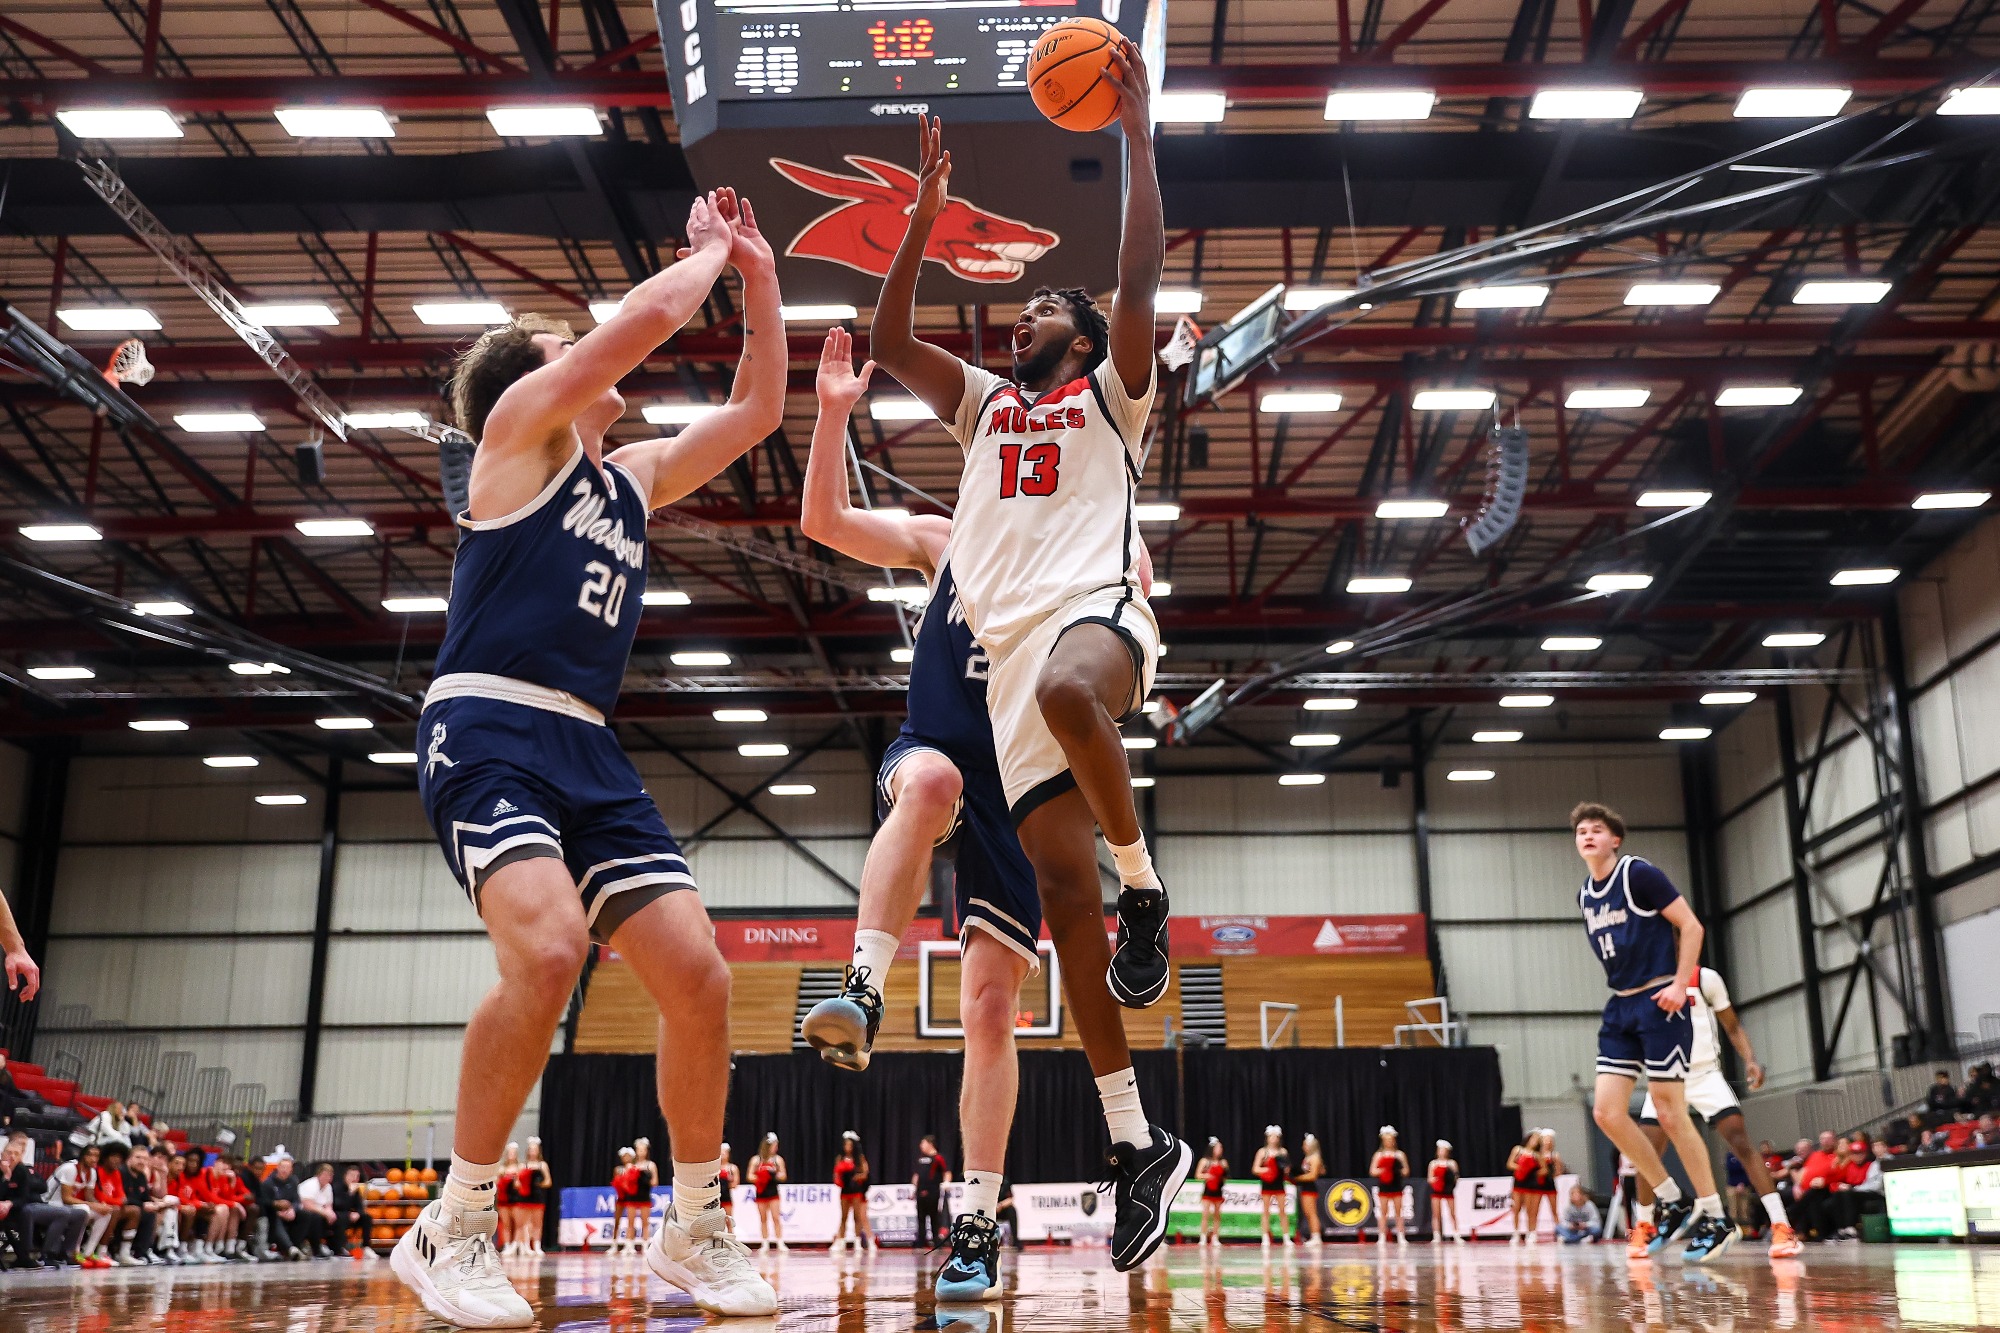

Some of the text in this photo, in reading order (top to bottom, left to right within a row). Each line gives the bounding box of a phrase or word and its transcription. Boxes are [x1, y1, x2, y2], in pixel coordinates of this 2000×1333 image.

[985, 406, 1086, 437] MULES
[999, 442, 1061, 499] 13
[578, 560, 627, 628] 20
[744, 927, 818, 944] DINING
[785, 1187, 832, 1203] HIGH
